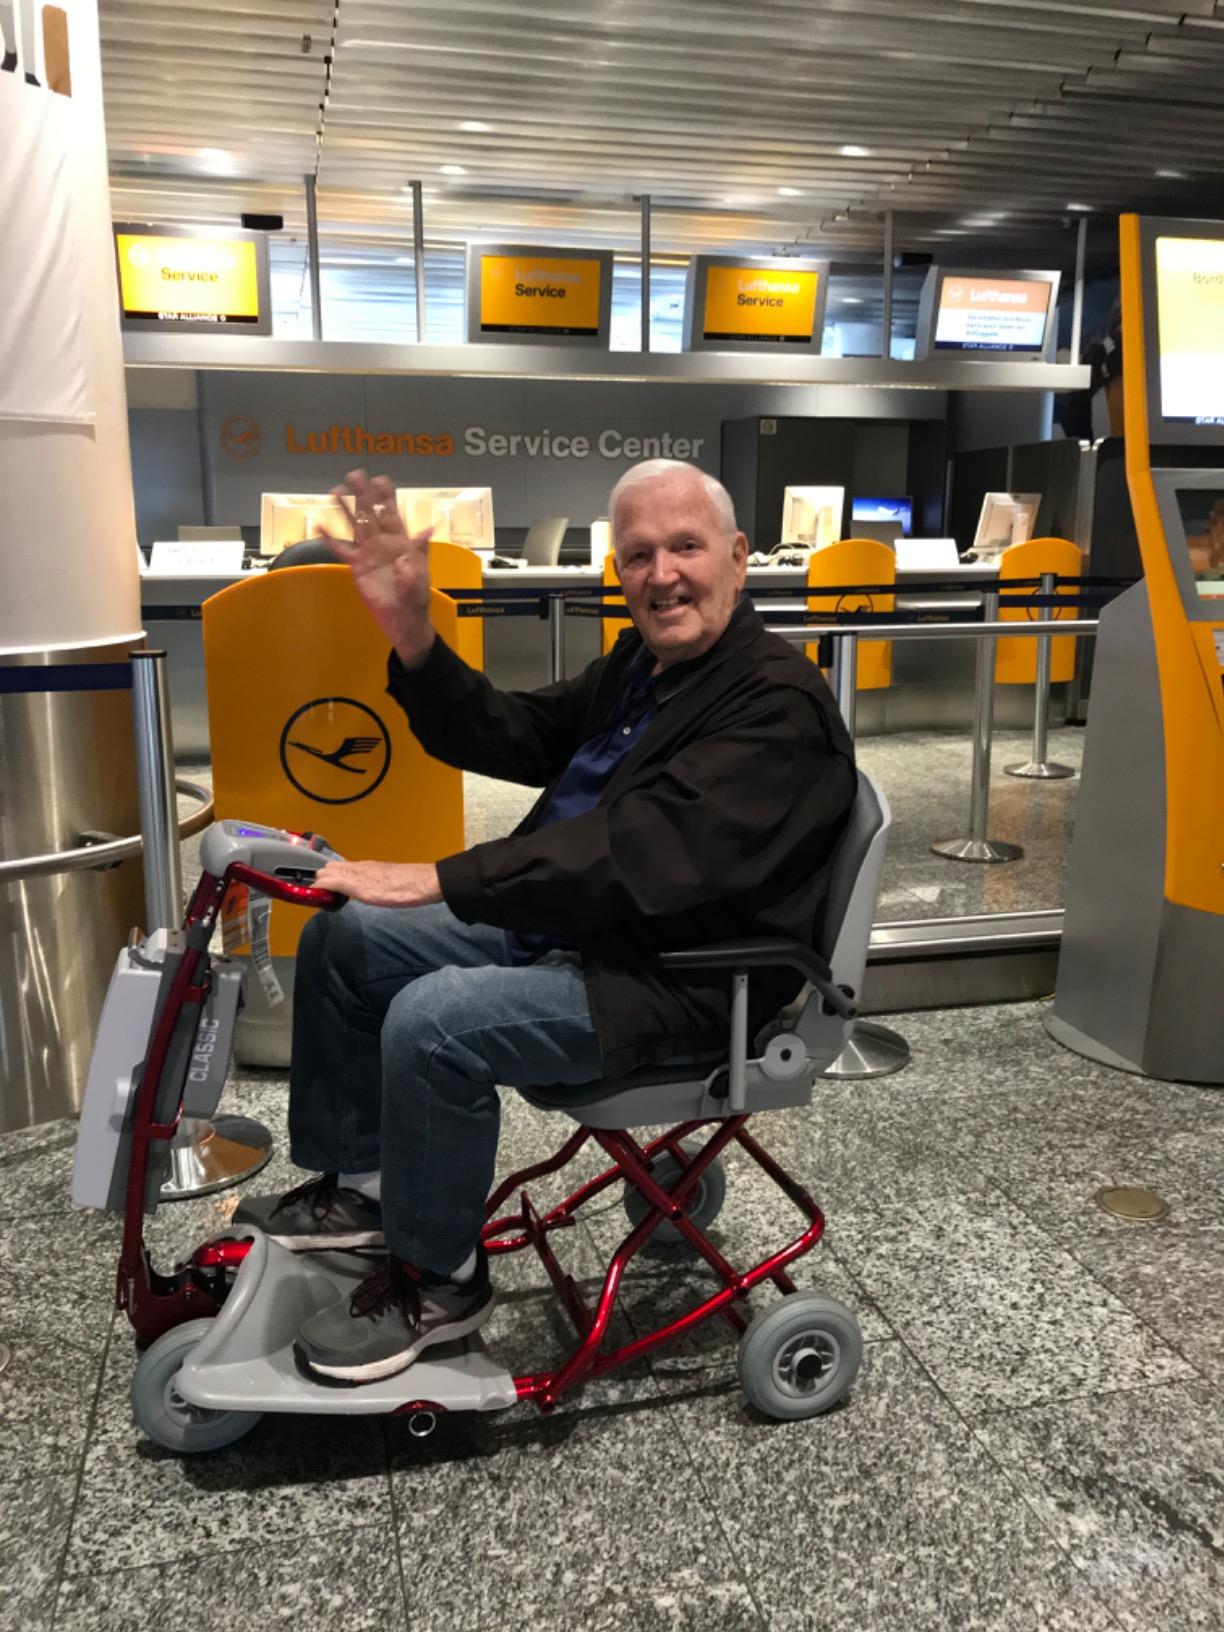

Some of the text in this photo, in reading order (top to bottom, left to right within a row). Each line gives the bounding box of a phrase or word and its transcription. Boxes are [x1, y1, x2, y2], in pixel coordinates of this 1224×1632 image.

[160, 266, 218, 282] Service
[515, 284, 566, 298] Service
[737, 279, 800, 294] Lufthansa
[737, 293, 783, 307] Service
[969, 287, 1028, 304] Lufthansa
[285, 423, 704, 458] Lufthansa Service Center
[189, 1018, 219, 1081] CLASSIC
